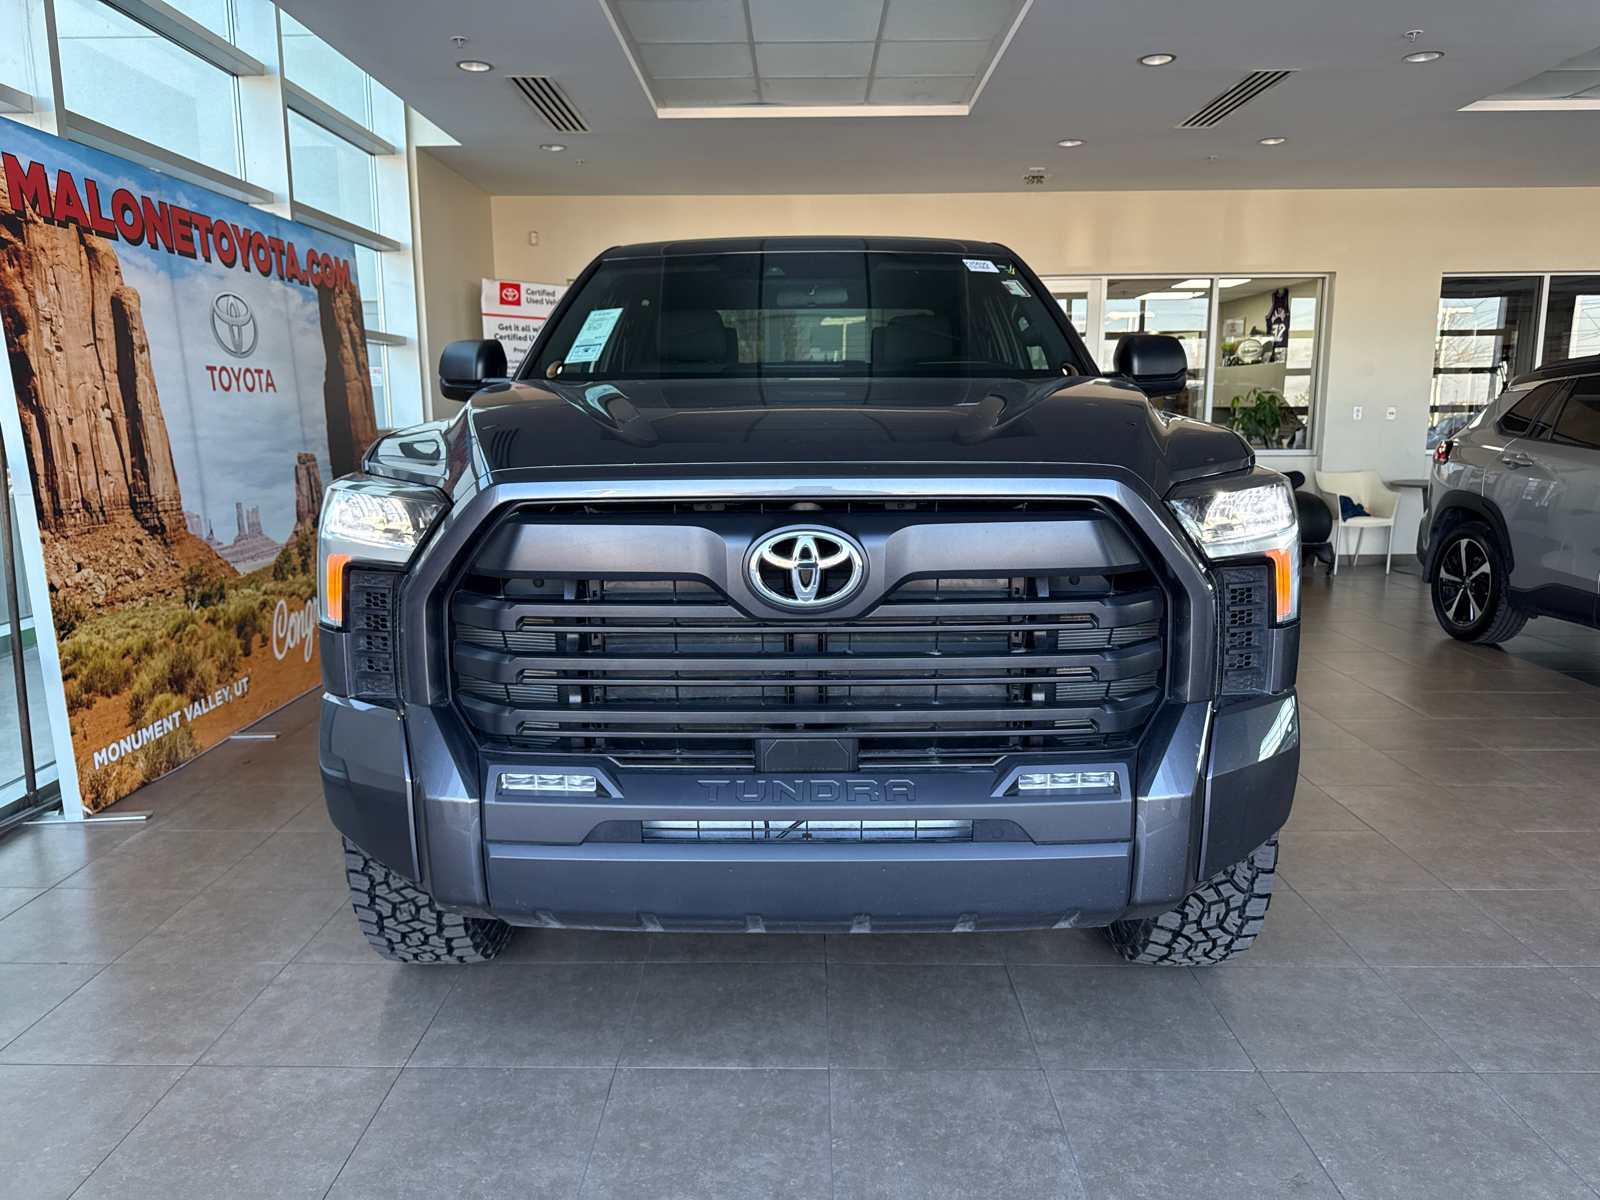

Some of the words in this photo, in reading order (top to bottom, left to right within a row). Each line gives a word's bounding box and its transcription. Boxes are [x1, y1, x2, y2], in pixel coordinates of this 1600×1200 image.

[2, 153, 351, 291] MALONETOYOTA.COM
[525, 288, 556, 298] Certified
[526, 296, 544, 305] Used
[545, 298, 559, 306] Veh
[498, 323, 512, 332] Get
[514, 324, 520, 332] it
[521, 324, 531, 332] all
[494, 333, 528, 342] Certified
[206, 365, 277, 393] TOYOTA
[93, 710, 181, 771] MONUMENT
[183, 685, 233, 722] VALLEY,
[233, 676, 249, 696] UT
[697, 779, 916, 802] TUNDRA
